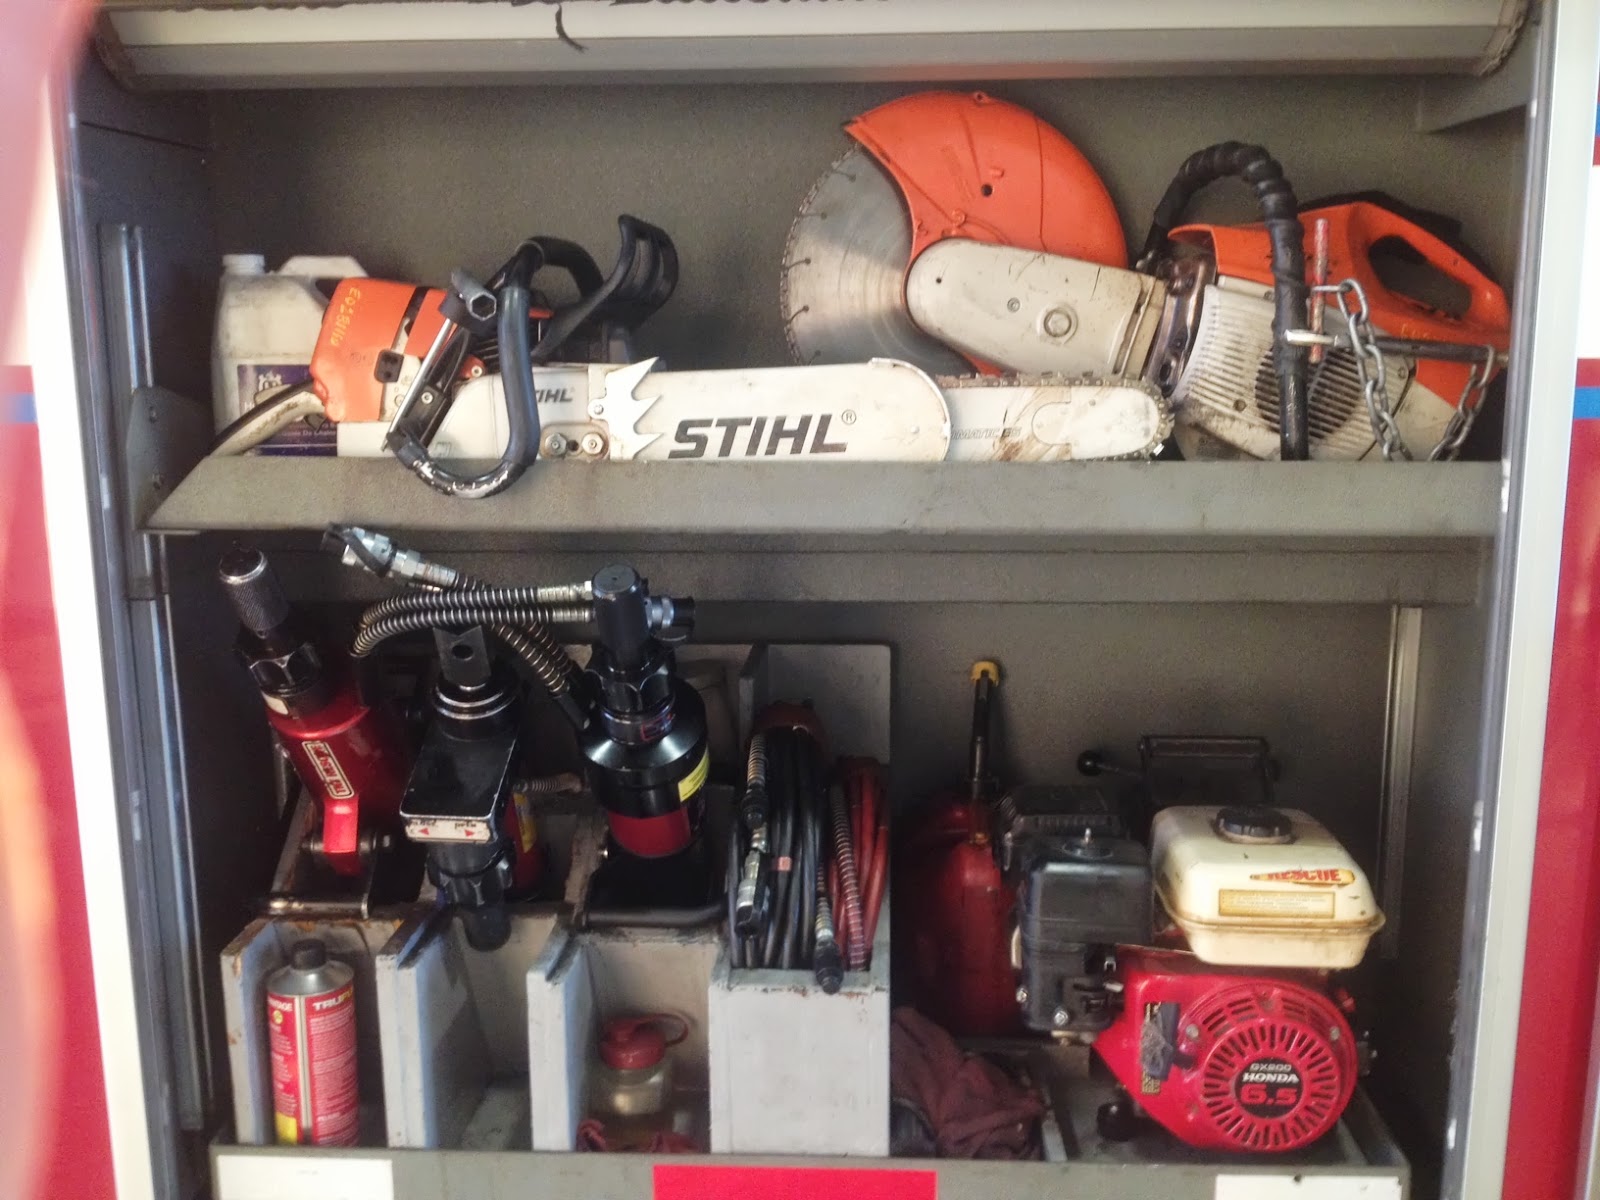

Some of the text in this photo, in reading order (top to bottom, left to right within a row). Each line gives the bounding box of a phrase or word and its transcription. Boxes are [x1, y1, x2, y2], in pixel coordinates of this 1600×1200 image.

[1265, 868, 1342, 881] RESCUE
[1249, 1062, 1293, 1073] GX200
[1241, 1072, 1300, 1084] HONDA
[1241, 1083, 1298, 1106] 6.5
